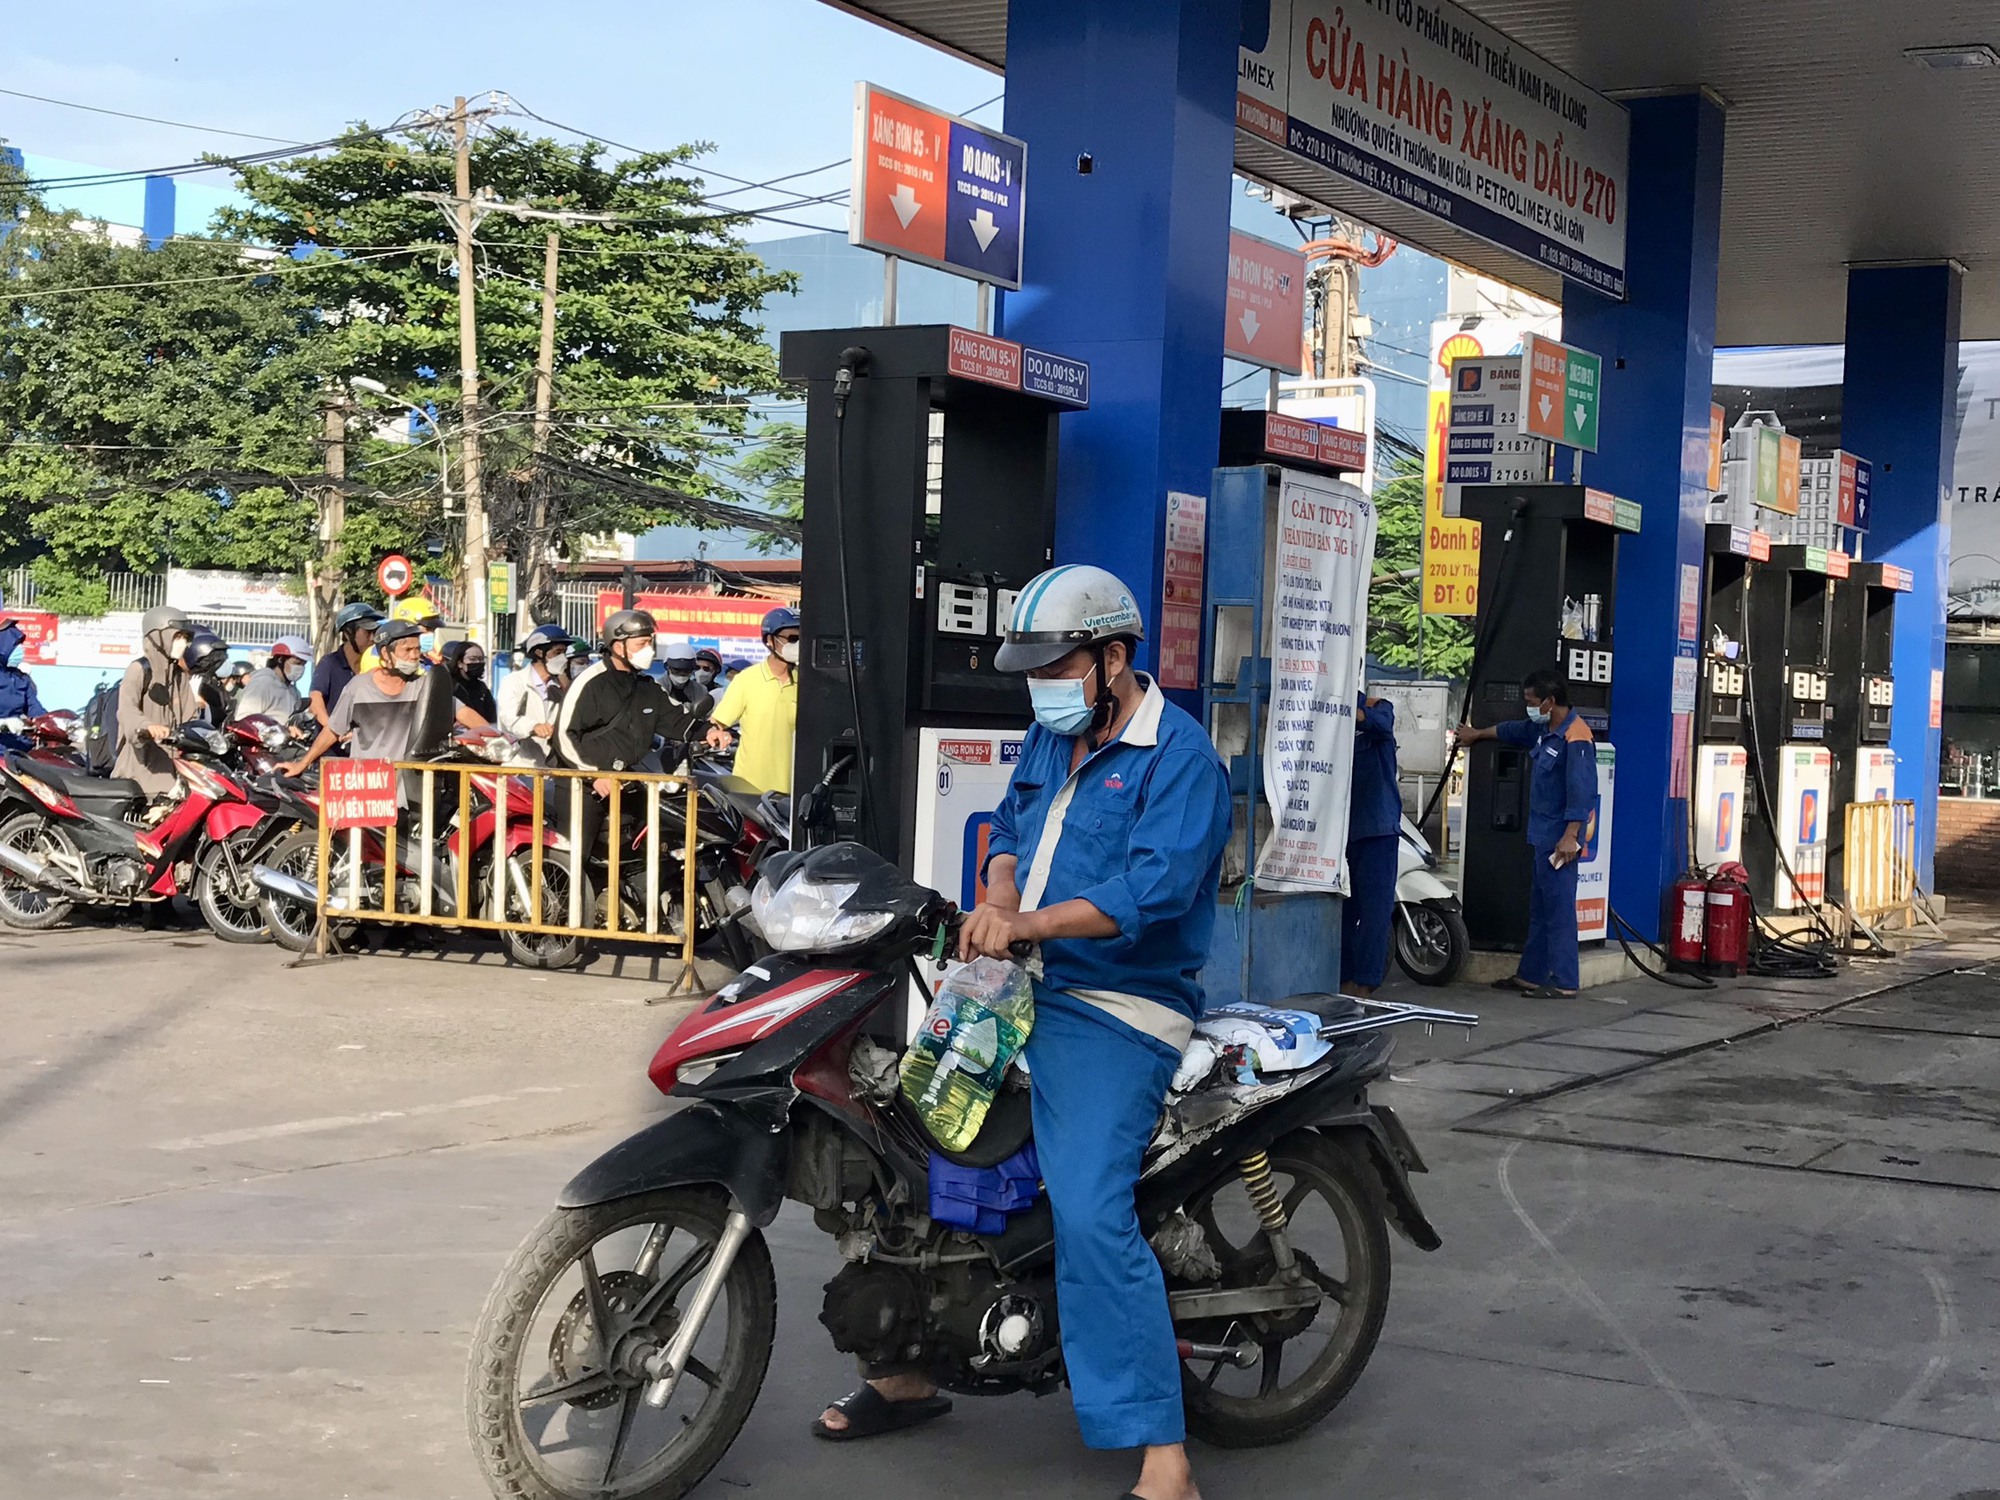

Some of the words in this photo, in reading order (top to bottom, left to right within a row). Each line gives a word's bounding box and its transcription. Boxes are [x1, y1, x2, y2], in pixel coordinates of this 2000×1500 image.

[1416, 6, 1449, 49] PHẦN
[1452, 27, 1482, 68] PHÁT
[1485, 46, 1517, 89] TRIỂN
[1519, 65, 1541, 102] NAM
[1543, 81, 1561, 114] PHI
[1562, 92, 1588, 130] LONG
[1306, 6, 1368, 104] CỬA
[1376, 47, 1453, 146] HÀNG
[1460, 97, 1528, 184] XĂNG
[1533, 131, 1580, 209] DẦU
[1582, 166, 1616, 225] 270
[872, 110, 895, 148] XĂNG
[895, 120, 913, 154] RON
[913, 127, 925, 158] 95
[962, 144, 974, 175] DO
[1331, 102, 1370, 143] NHƯỢNG
[1371, 121, 1401, 158] QUYỀN
[1403, 138, 1437, 175] THƯƠNG
[1438, 153, 1454, 187] MẠI
[1455, 161, 1472, 191] CỦA
[1476, 174, 1552, 229] PETROLIMEX
[1553, 208, 1567, 237] SÀI
[1242, 258, 1261, 287] RON
[1262, 266, 1275, 291] 95
[953, 334, 978, 358] XĂNG
[979, 344, 998, 363] RON
[998, 351, 1018, 369] 95-V
[960, 358, 976, 372] TCCS
[1027, 356, 1043, 375] DO
[1044, 362, 1085, 386] 0,001S-V
[1033, 377, 1048, 391] TCCS
[1291, 492, 1315, 521] CẦN
[1430, 526, 1467, 550] Đánh
[1430, 563, 1447, 577] 270
[1434, 585, 1460, 604] ĐT:
[1084, 611, 1136, 628] Vietcombak
[960, 744, 975, 755] RON
[975, 744, 990, 756] 95-V
[1003, 745, 1016, 755] DO
[329, 773, 342, 791] XE
[366, 767, 389, 790] MÁY
[940, 771, 950, 789] 01
[345, 795, 365, 819] BÊN
[365, 799, 396, 818] TRONG
